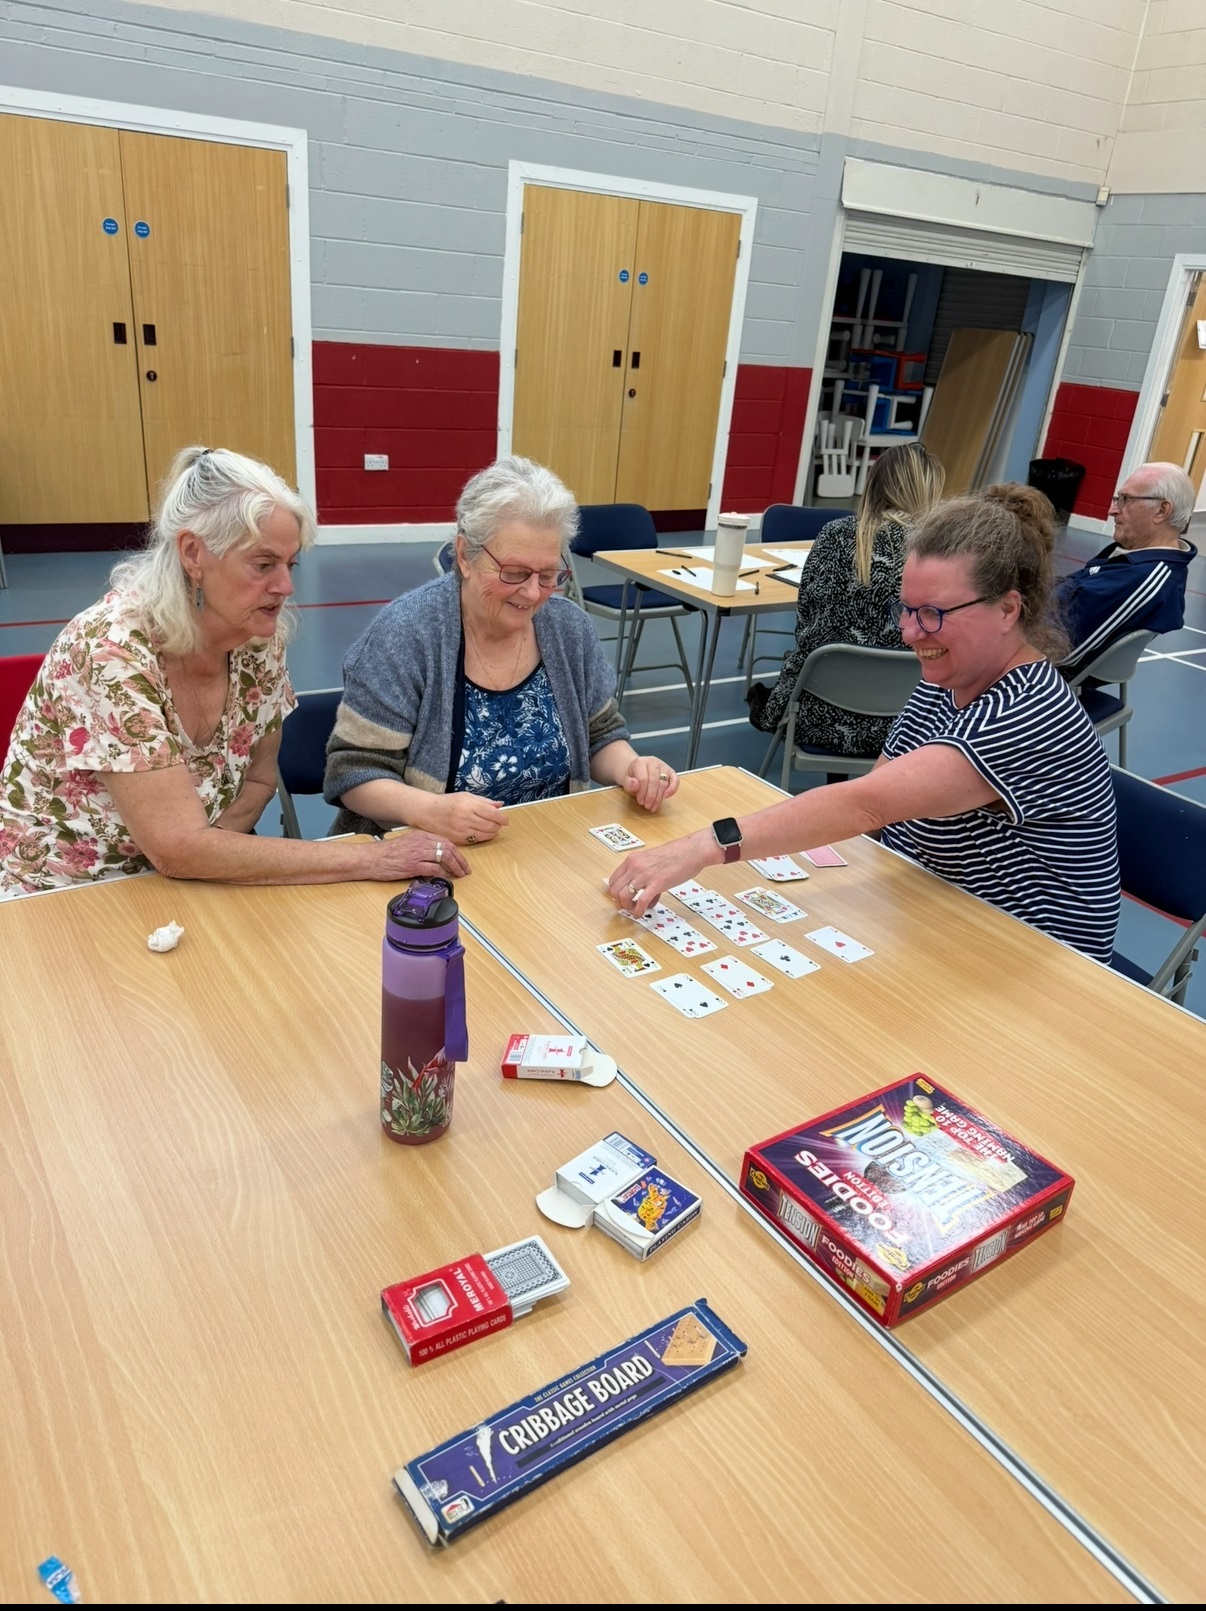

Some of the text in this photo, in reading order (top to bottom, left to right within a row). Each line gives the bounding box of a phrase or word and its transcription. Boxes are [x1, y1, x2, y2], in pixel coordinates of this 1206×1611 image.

[935, 1104, 1015, 1161] NAMING GAME
[936, 1115, 951, 1126] 10
[951, 1126, 973, 1144] TOP
[831, 1110, 988, 1226] TENSION
[794, 1150, 911, 1245] FOODIES
[844, 1171, 889, 1210] EDITION
[778, 1194, 820, 1247] TENSION
[821, 1235, 870, 1283] FOODIES
[832, 1256, 854, 1278] EDITION
[926, 1257, 970, 1289] FOODIES
[454, 1268, 485, 1312] MEROYAL
[419, 1347, 428, 1357] 100
[435, 1341, 445, 1350] ALL
[446, 1331, 467, 1345] PLASTIC
[468, 1322, 489, 1336] PLAYING
[490, 1314, 507, 1326] CARDS
[499, 1355, 653, 1455] CRIBBAGE BOARD
[535, 1365, 596, 1403] THE CLASSIC GAMES COLLECTION
